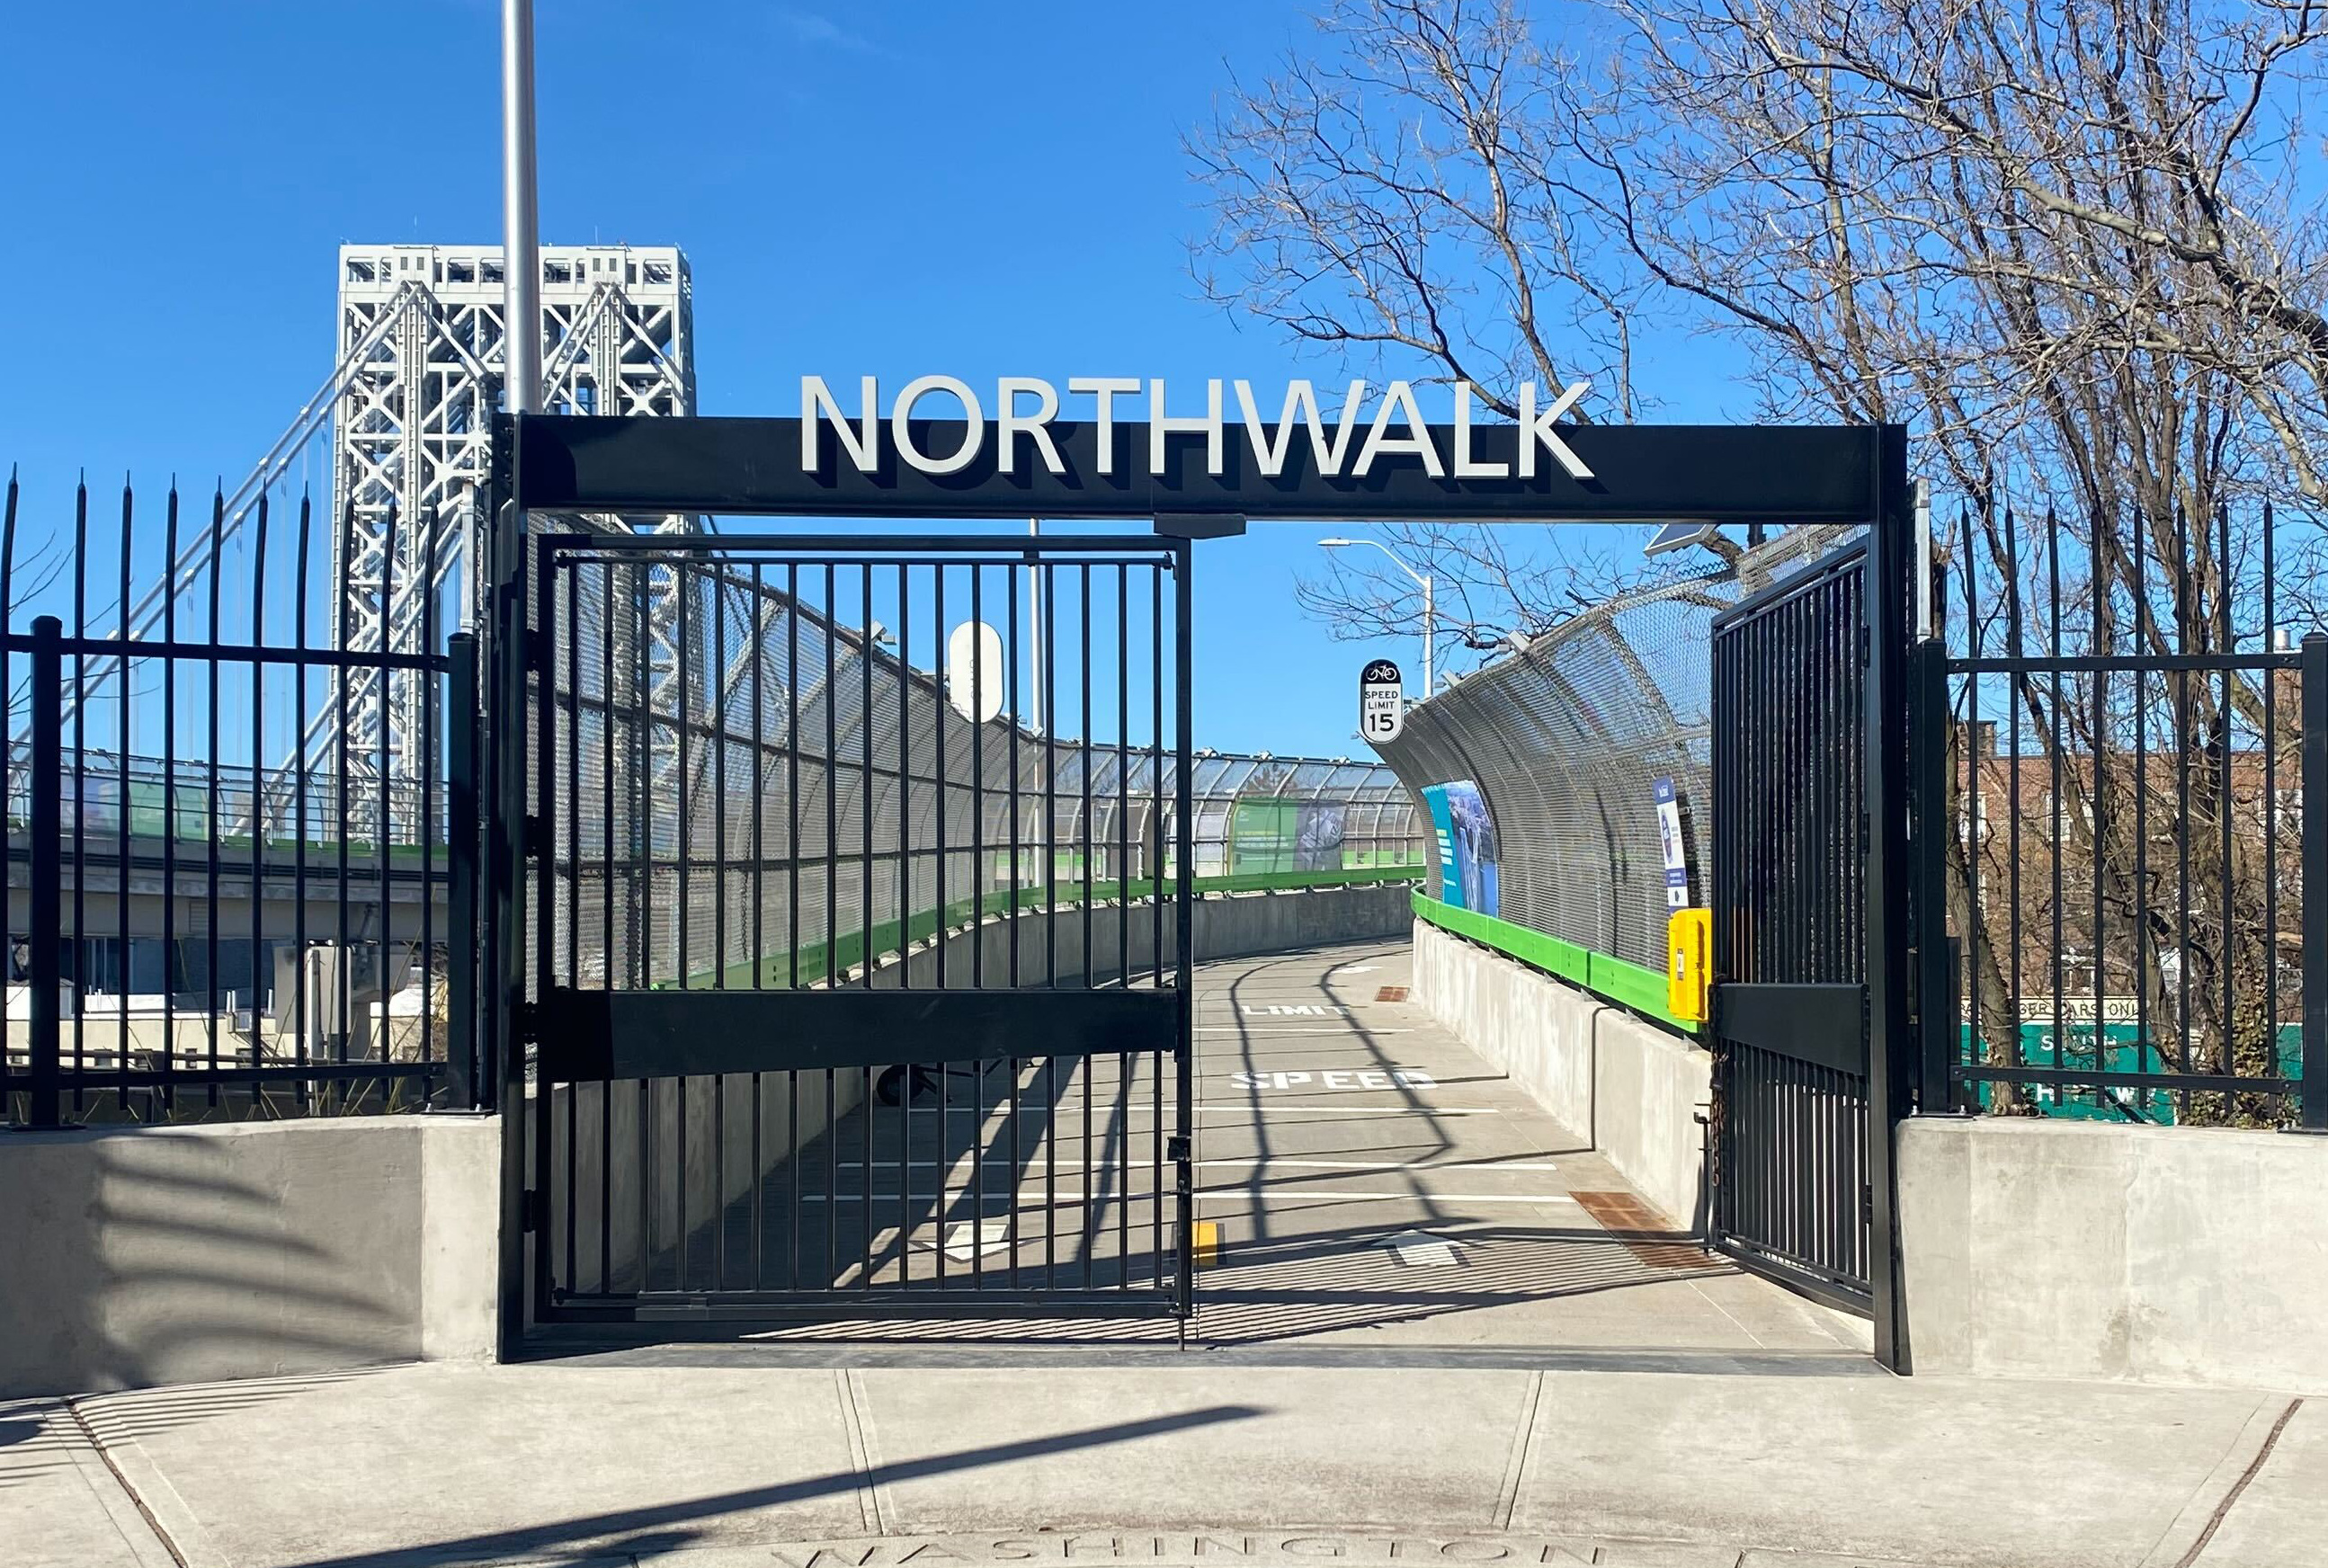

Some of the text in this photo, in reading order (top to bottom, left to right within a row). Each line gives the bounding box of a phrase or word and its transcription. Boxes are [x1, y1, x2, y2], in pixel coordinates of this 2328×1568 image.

[801, 375, 1595, 479] NORTHWALK
[1365, 690, 1398, 699] SPEED
[1368, 701, 1395, 710] LIMIT
[1369, 713, 1394, 732] 15
[1242, 1005, 1351, 1016] LIMIT
[2109, 1003, 2139, 1016] ONL
[2040, 1035, 2118, 1052] STH
[1231, 1071, 1439, 1090] SPEED
[772, 1537, 1608, 1568] WASHINGTON
